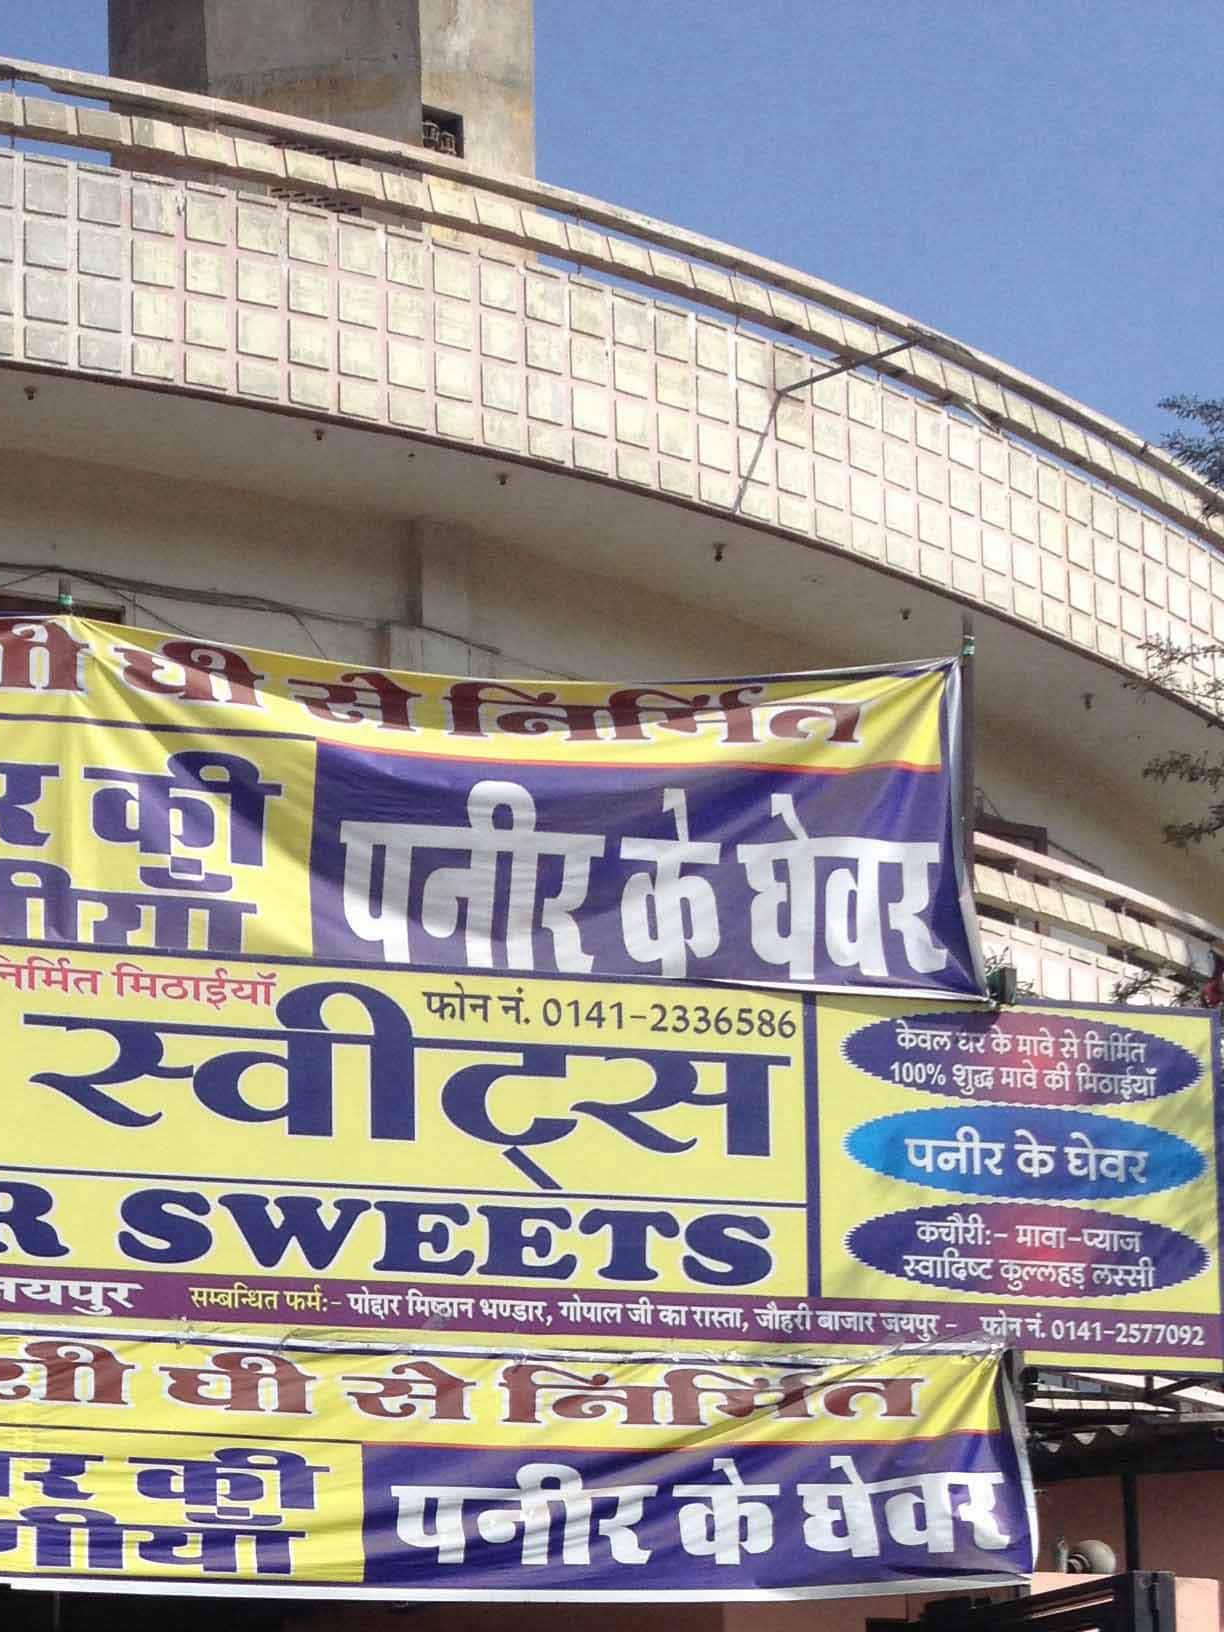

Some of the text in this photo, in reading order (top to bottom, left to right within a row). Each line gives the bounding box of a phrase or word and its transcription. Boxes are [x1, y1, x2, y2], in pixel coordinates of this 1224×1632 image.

[113, 640, 266, 708] घी
[288, 673, 426, 733] से
[451, 683, 864, 745] निर्मित
[83, 750, 282, 866] की
[339, 780, 948, 980] पनीर के घेवर
[422, 981, 798, 1039] फोन नं. 0141-2336586
[895, 1020, 1147, 1064] केवल घर के मावे से निर्मित
[23, 981, 792, 1190] स्वीट्स
[891, 1062, 947, 1086] 100%
[999, 1060, 1039, 1090] मावे
[1043, 1062, 1072, 1092] की
[905, 1126, 1150, 1184] पनीर के घेवर
[116, 1188, 774, 1287] SWEETS
[902, 1246, 994, 1281] स्वादिष्ट
[1091, 1256, 1156, 1289] लस्सी
[189, 1282, 280, 1310] सम्बन्धित
[347, 1286, 403, 1320] पोद्दार
[479, 1298, 553, 1326] भण्डार,
[557, 1294, 623, 1324] गोपाल
[626, 1297, 654, 1326] जी
[657, 1304, 688, 1327] का
[691, 1306, 750, 1333] रास्ता,
[753, 1302, 812, 1334] जौहरी
[816, 1311, 876, 1334] बाजार
[880, 1313, 941, 1341] जयपुर
[980, 1308, 1023, 1339] फोन
[1050, 1320, 1206, 1347] 0141-2577092
[158, 1351, 317, 1415] घी
[343, 1362, 478, 1422] से
[503, 1366, 926, 1428] निर्मित
[128, 1448, 331, 1515] की
[391, 1455, 1011, 1565] पनीर के घेवर
